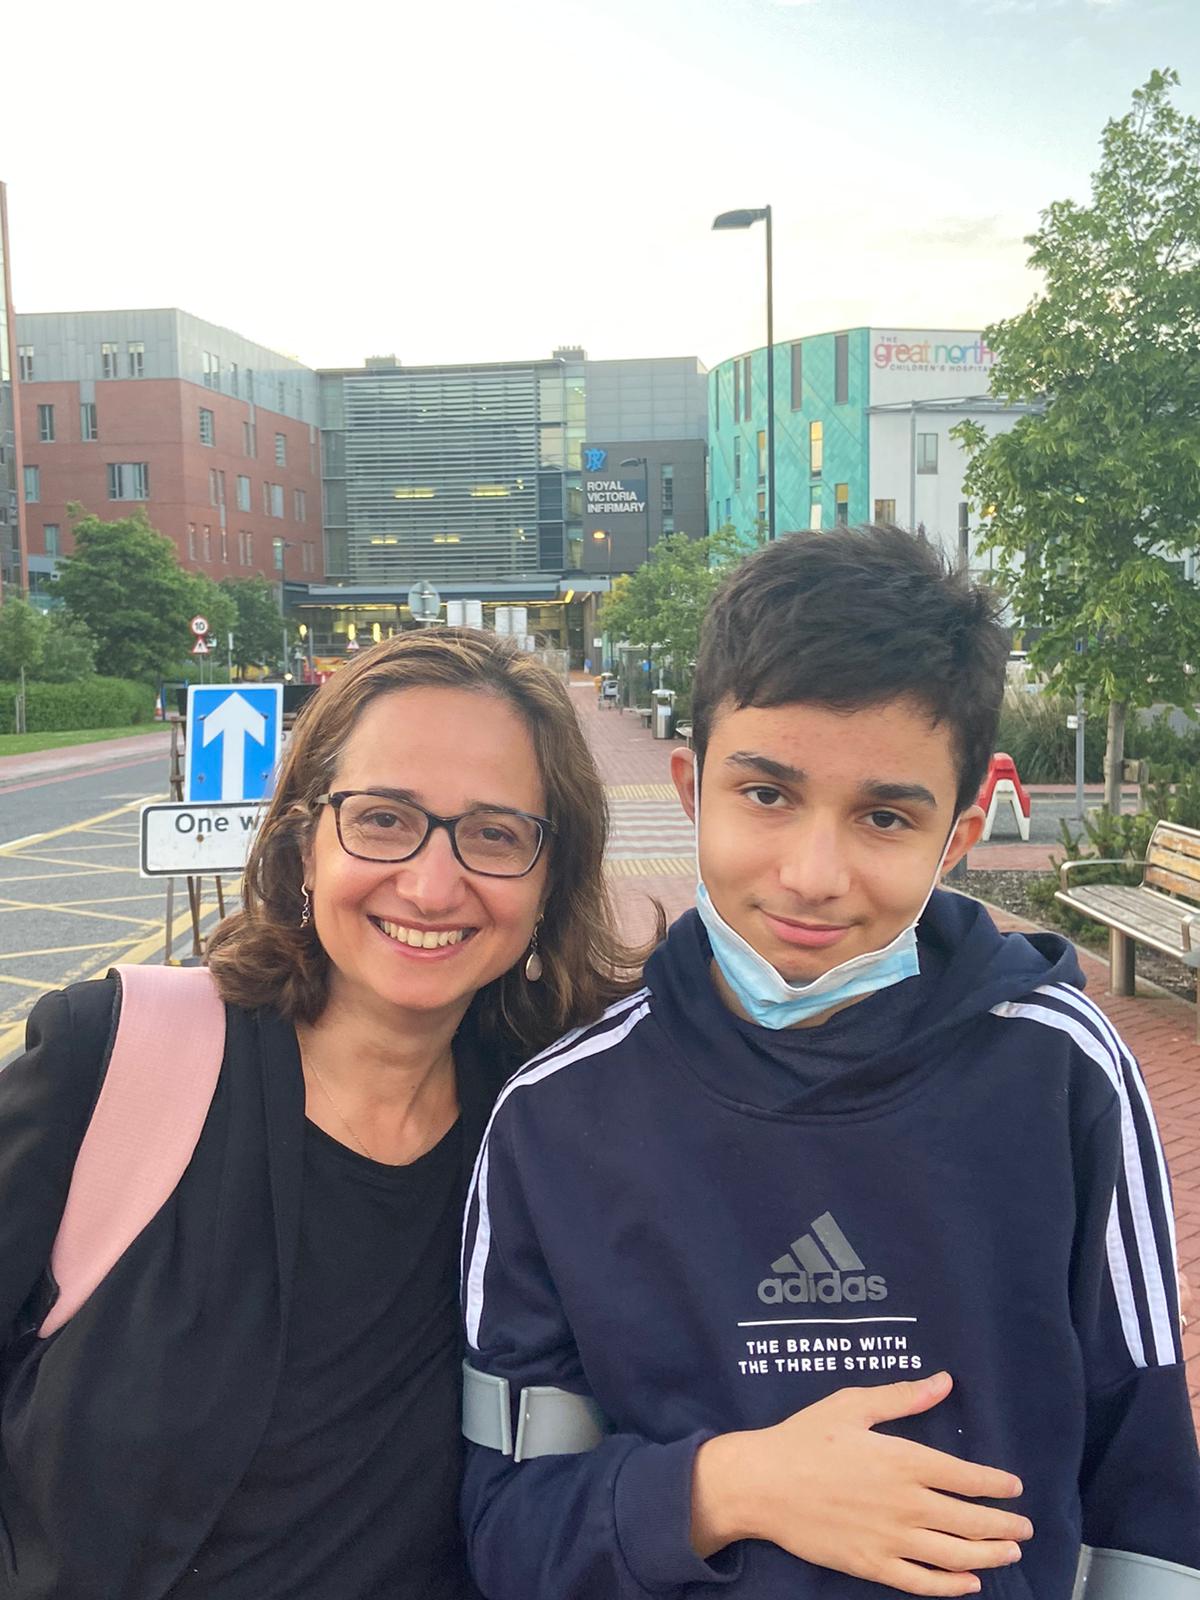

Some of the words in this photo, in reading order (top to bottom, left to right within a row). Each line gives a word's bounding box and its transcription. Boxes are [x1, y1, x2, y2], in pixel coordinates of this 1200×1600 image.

[874, 342, 930, 369] great
[935, 338, 994, 364] north
[889, 364, 945, 372] CHILDREN'S
[586, 481, 624, 491] ROYAL
[586, 491, 638, 502] VICTORIA
[587, 502, 645, 513] INFIRMARY
[194, 621, 206, 631] 10
[175, 813, 229, 834] One
[240, 815, 261, 831] w
[757, 1270, 888, 1304] adidas
[746, 1340, 779, 1354] THE
[787, 1338, 852, 1354] BRAND
[860, 1336, 907, 1350] WITH
[738, 1360, 768, 1375] THE
[775, 1357, 837, 1372] THREE
[844, 1355, 922, 1371] STRIPES
